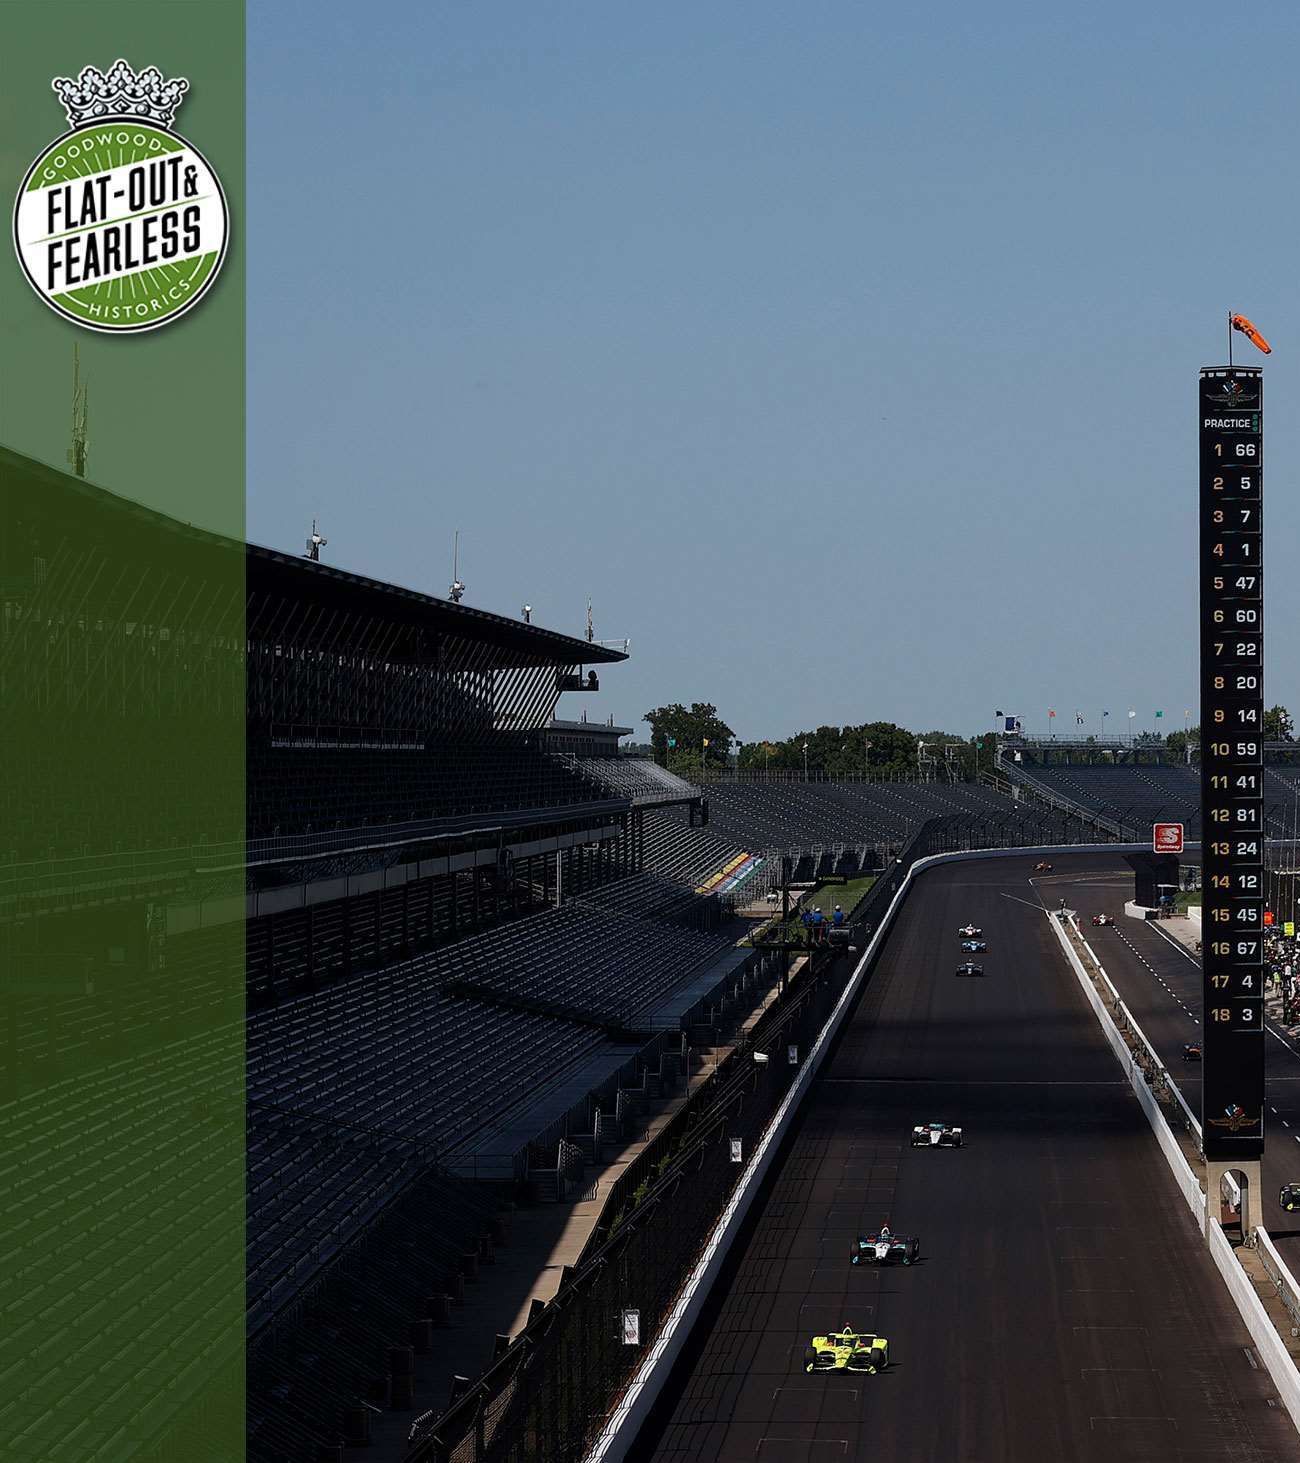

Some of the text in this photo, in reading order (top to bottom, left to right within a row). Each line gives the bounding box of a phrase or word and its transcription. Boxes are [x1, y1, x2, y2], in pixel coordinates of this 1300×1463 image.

[1204, 418, 1251, 428] PRACTICE
[1215, 444, 1255, 456] 1 66
[1213, 477, 1250, 489] 2 5
[1213, 510, 1250, 523] 3 7
[1213, 544, 1249, 556] 4 1
[1213, 577, 1255, 589] 5 47
[1213, 610, 1256, 622] 6 60
[1214, 643, 1256, 655] 7 22
[1214, 676, 1256, 689] 8 20
[1214, 710, 1256, 722] 9 14
[1211, 743, 1256, 755] 10 59
[1211, 776, 1255, 788] 11 41
[1211, 809, 1256, 821] 12 81
[1211, 842, 1257, 855] 13 24
[1211, 876, 1257, 888] 14 12
[1211, 909, 1256, 921] 15 45
[1211, 942, 1257, 954] 16 67
[1211, 976, 1253, 988] 17 4
[1211, 1009, 1252, 1021] 18 3
